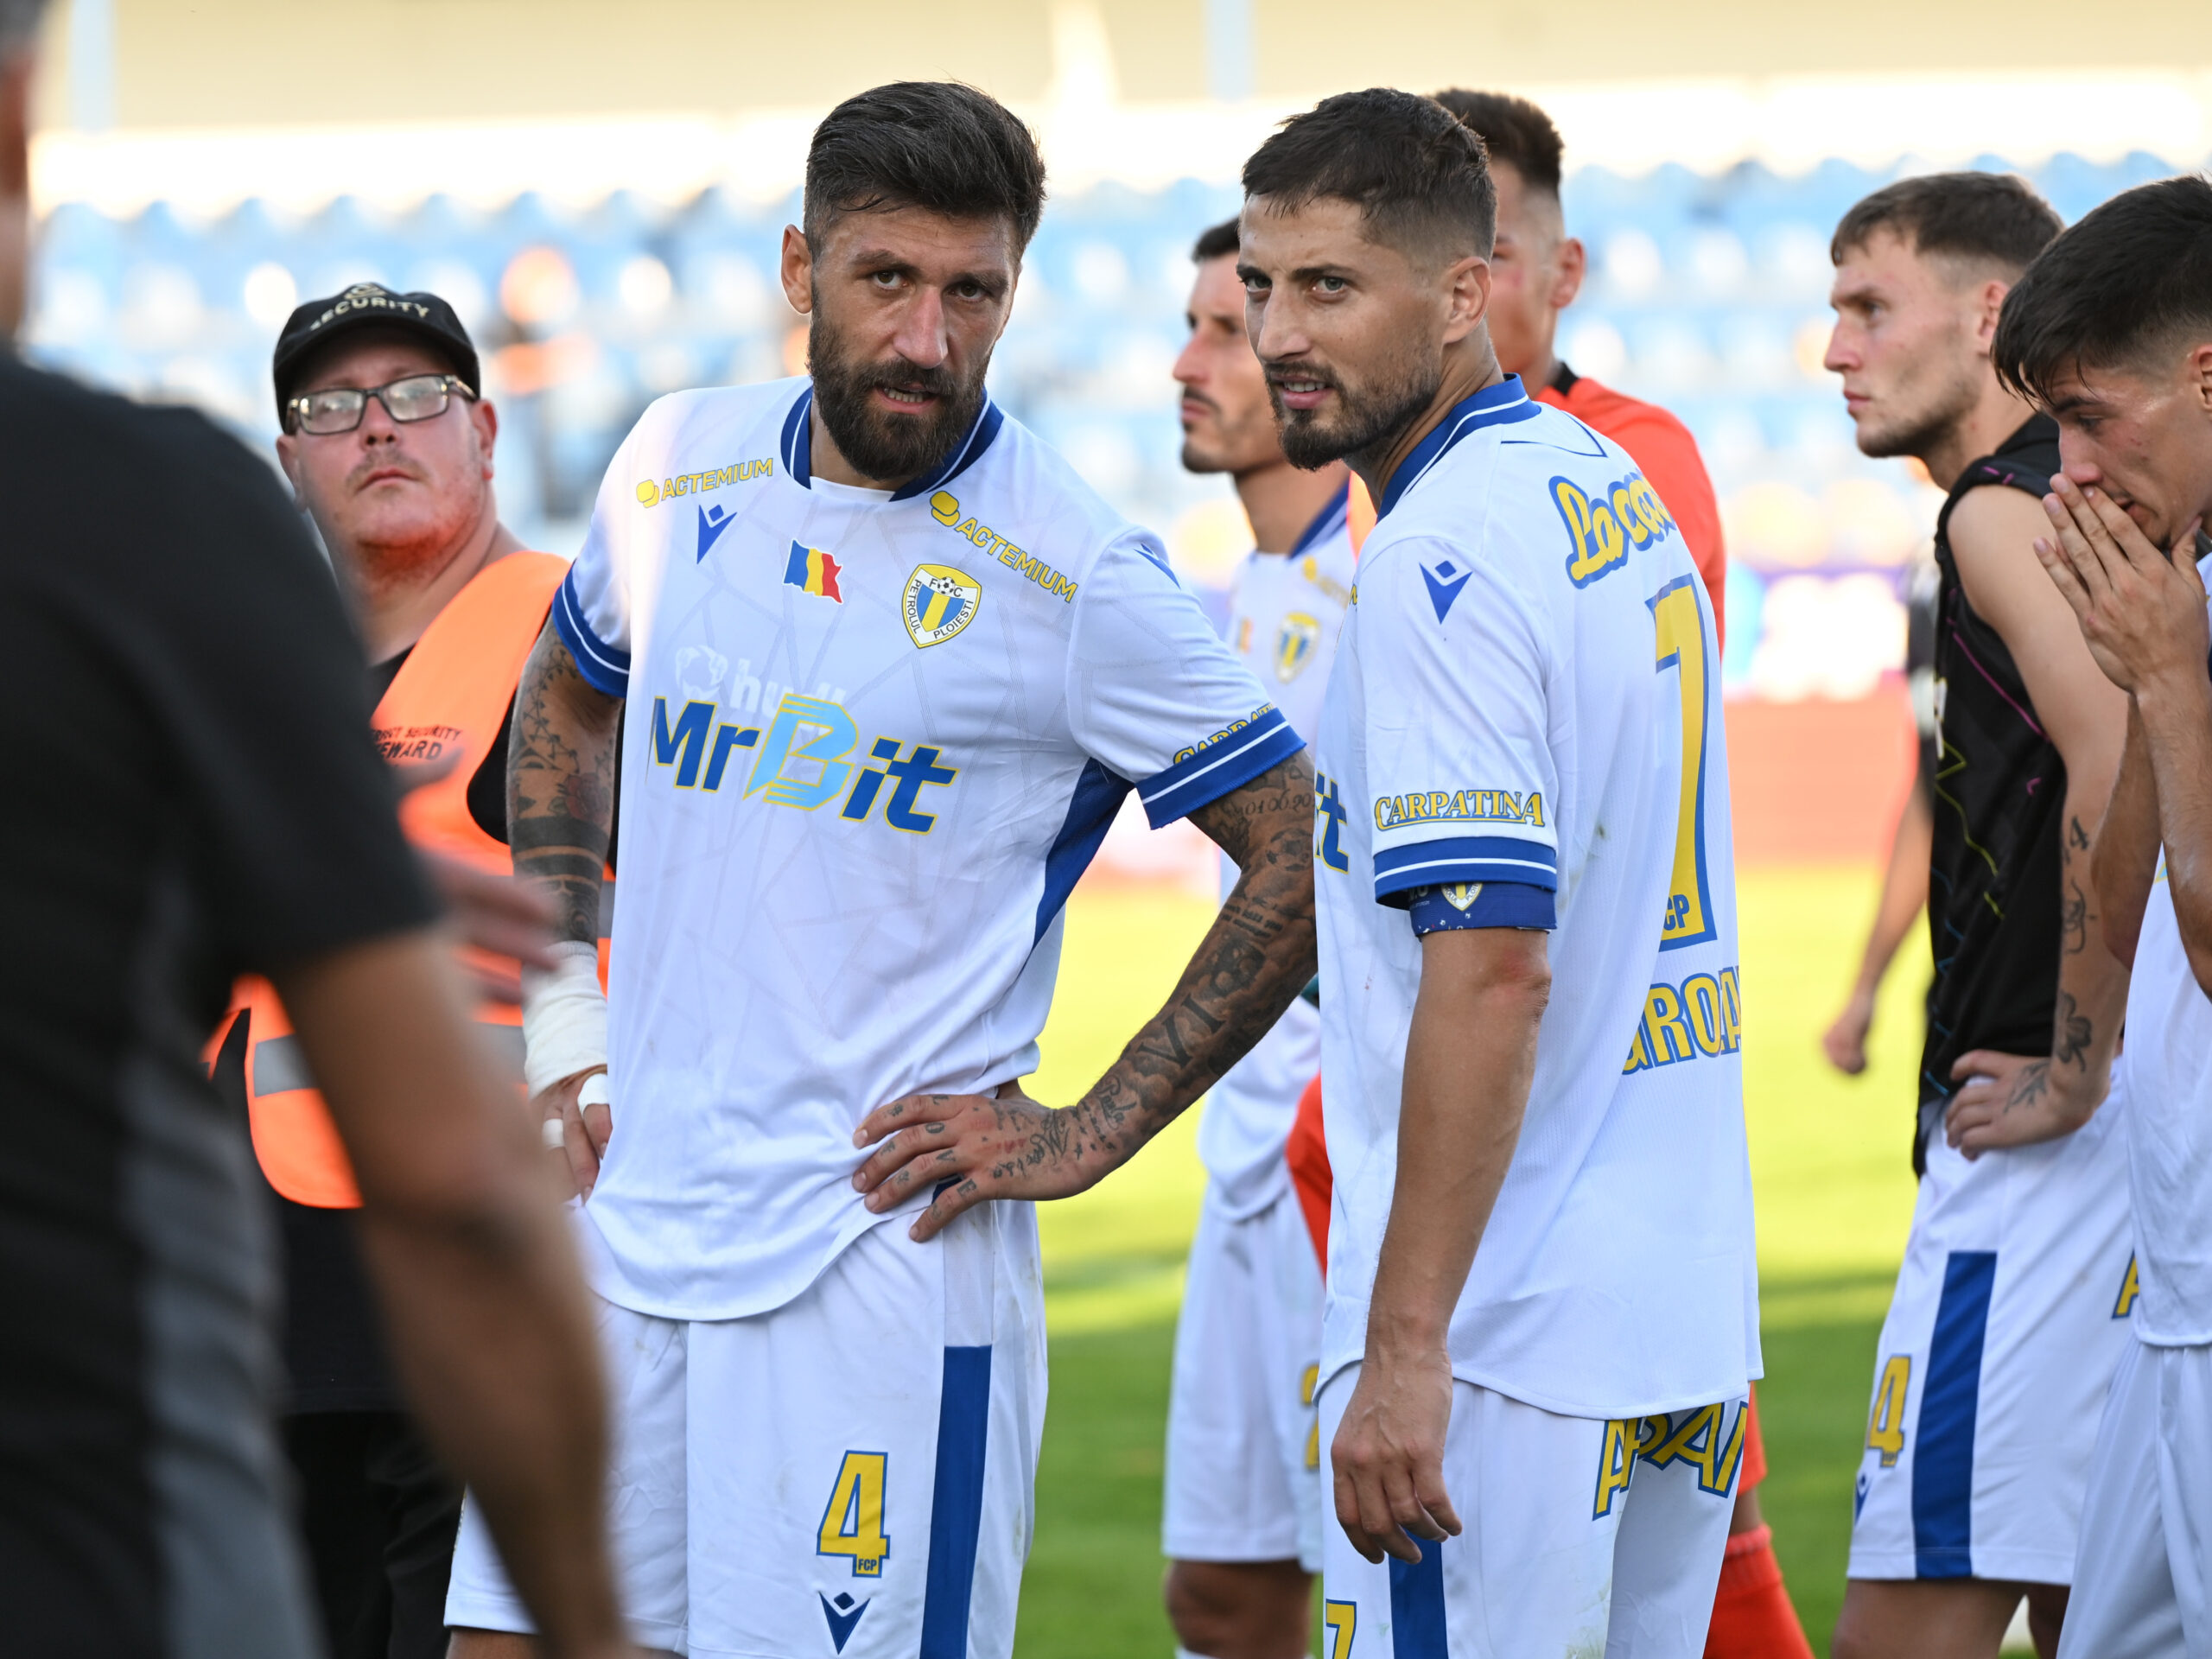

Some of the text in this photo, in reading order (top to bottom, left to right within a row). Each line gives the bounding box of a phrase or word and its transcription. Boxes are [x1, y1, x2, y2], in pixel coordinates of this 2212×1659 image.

[662, 458, 773, 501] ACTEMIUM
[954, 517, 1078, 603] ACTEMIUM
[906, 579, 974, 639] PETROLUL PLOIESTI
[378, 741, 443, 760] EWARD
[648, 696, 960, 836] MrBit
[1374, 790, 1545, 831] CARPATINA
[1663, 894, 1690, 931] CP
[1867, 1355, 1911, 1468] 4
[817, 1450, 890, 1578] 4
[858, 1559, 877, 1571] FCP
